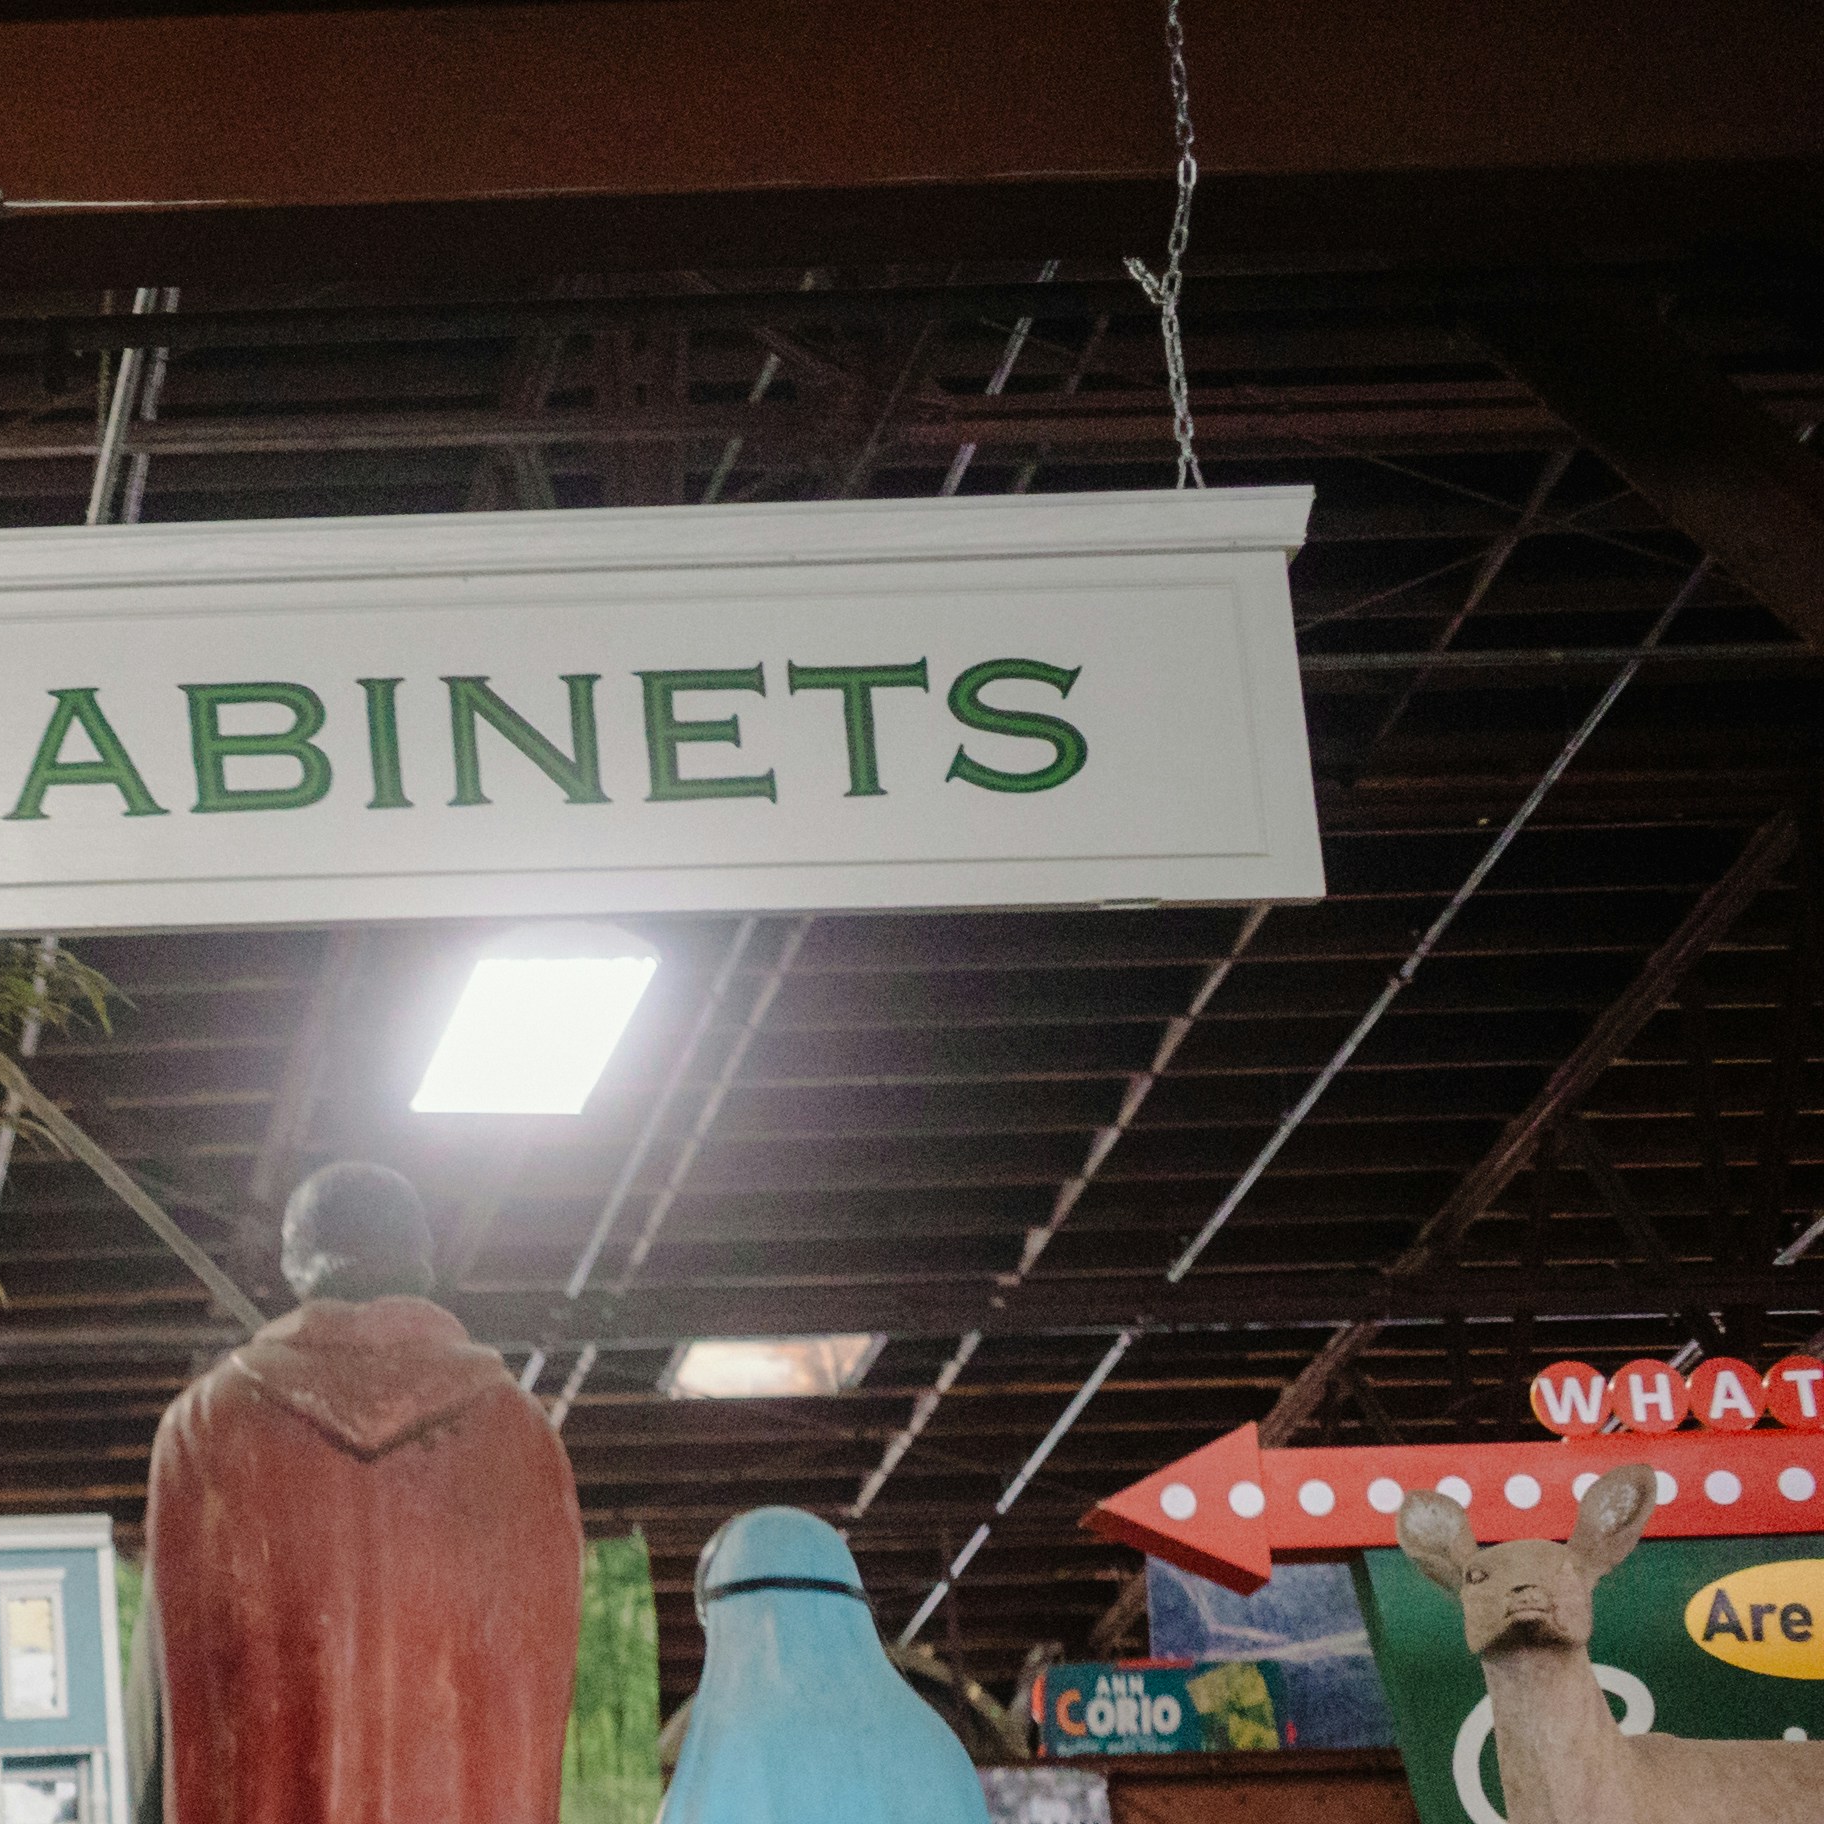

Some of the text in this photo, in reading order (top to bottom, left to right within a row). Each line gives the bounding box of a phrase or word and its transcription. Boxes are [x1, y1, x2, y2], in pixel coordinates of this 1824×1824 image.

[1536, 1367, 1824, 1425] WHAT
[1702, 1587, 1813, 1642] Are
[1055, 1688, 1183, 1738] CORIO
